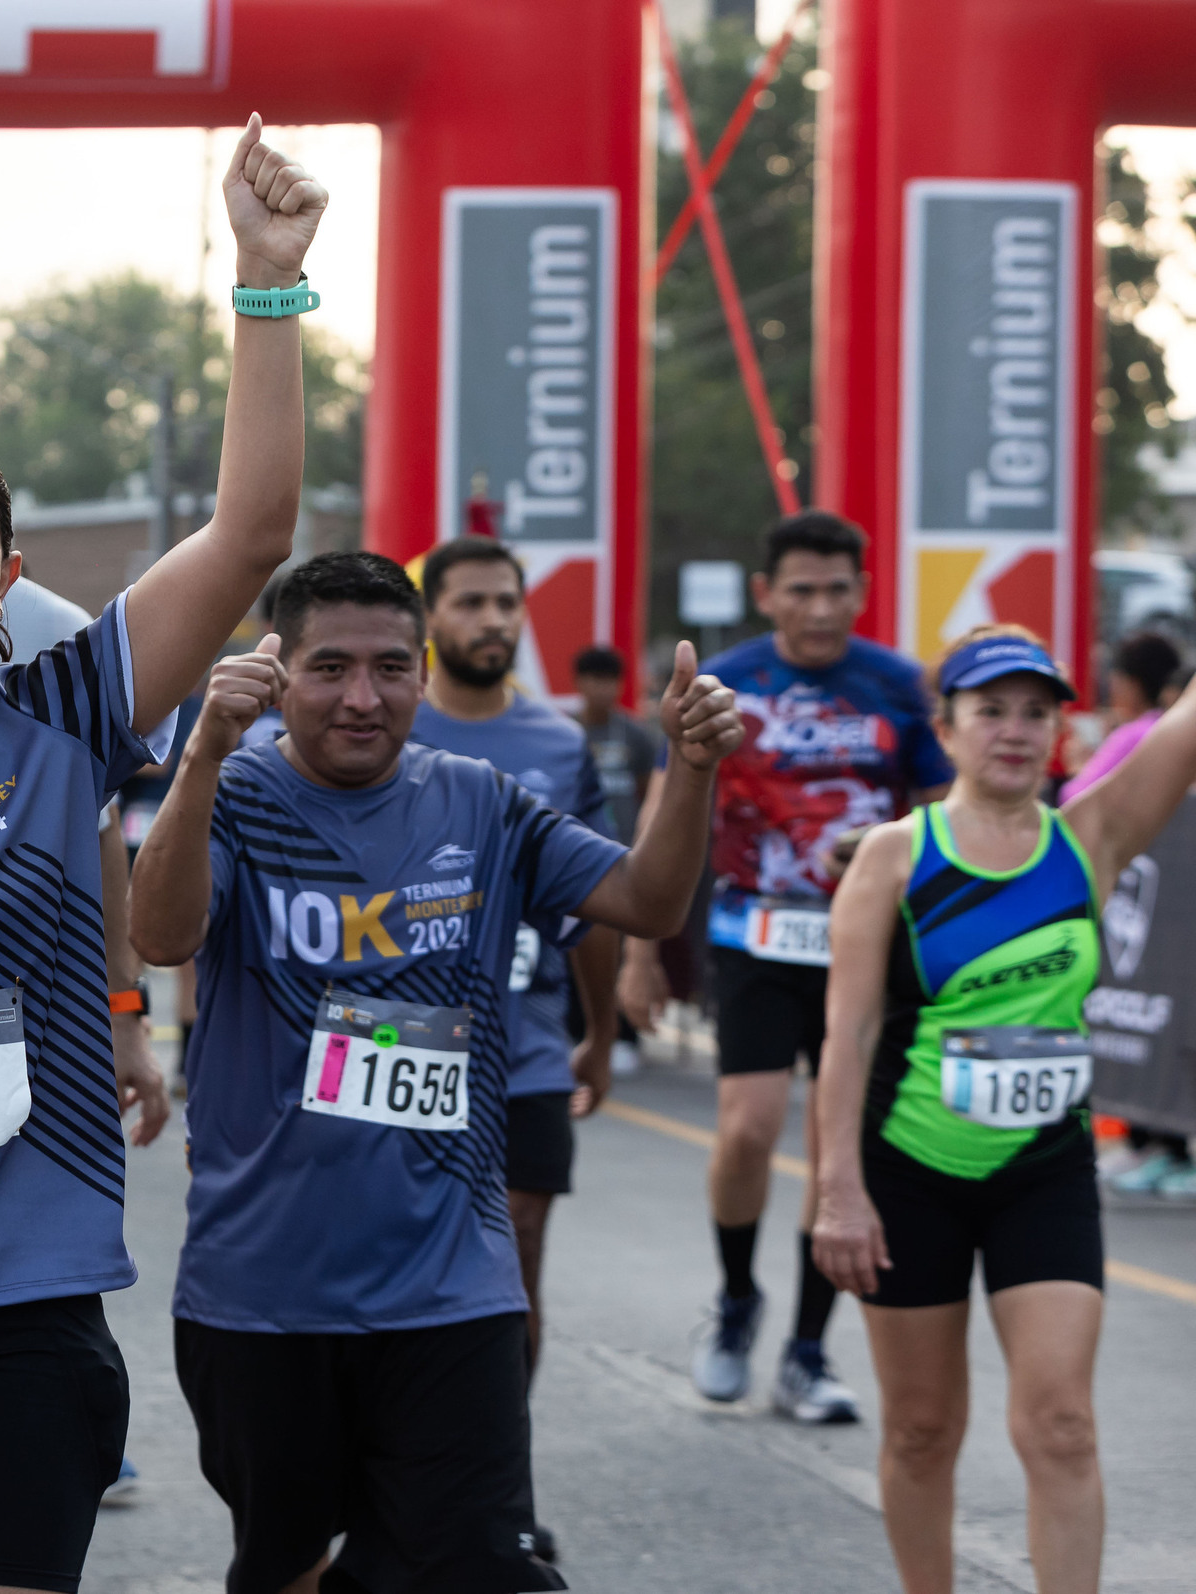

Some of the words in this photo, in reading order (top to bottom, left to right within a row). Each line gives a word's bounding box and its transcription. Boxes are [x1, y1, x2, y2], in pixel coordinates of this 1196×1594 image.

[505, 223, 590, 532] Ternium
[965, 216, 1054, 524] Ternium
[268, 885, 406, 965] 10K
[401, 876, 474, 903] TERNIUM
[361, 1052, 461, 1117] 1659
[987, 1066, 1079, 1114] 1867
